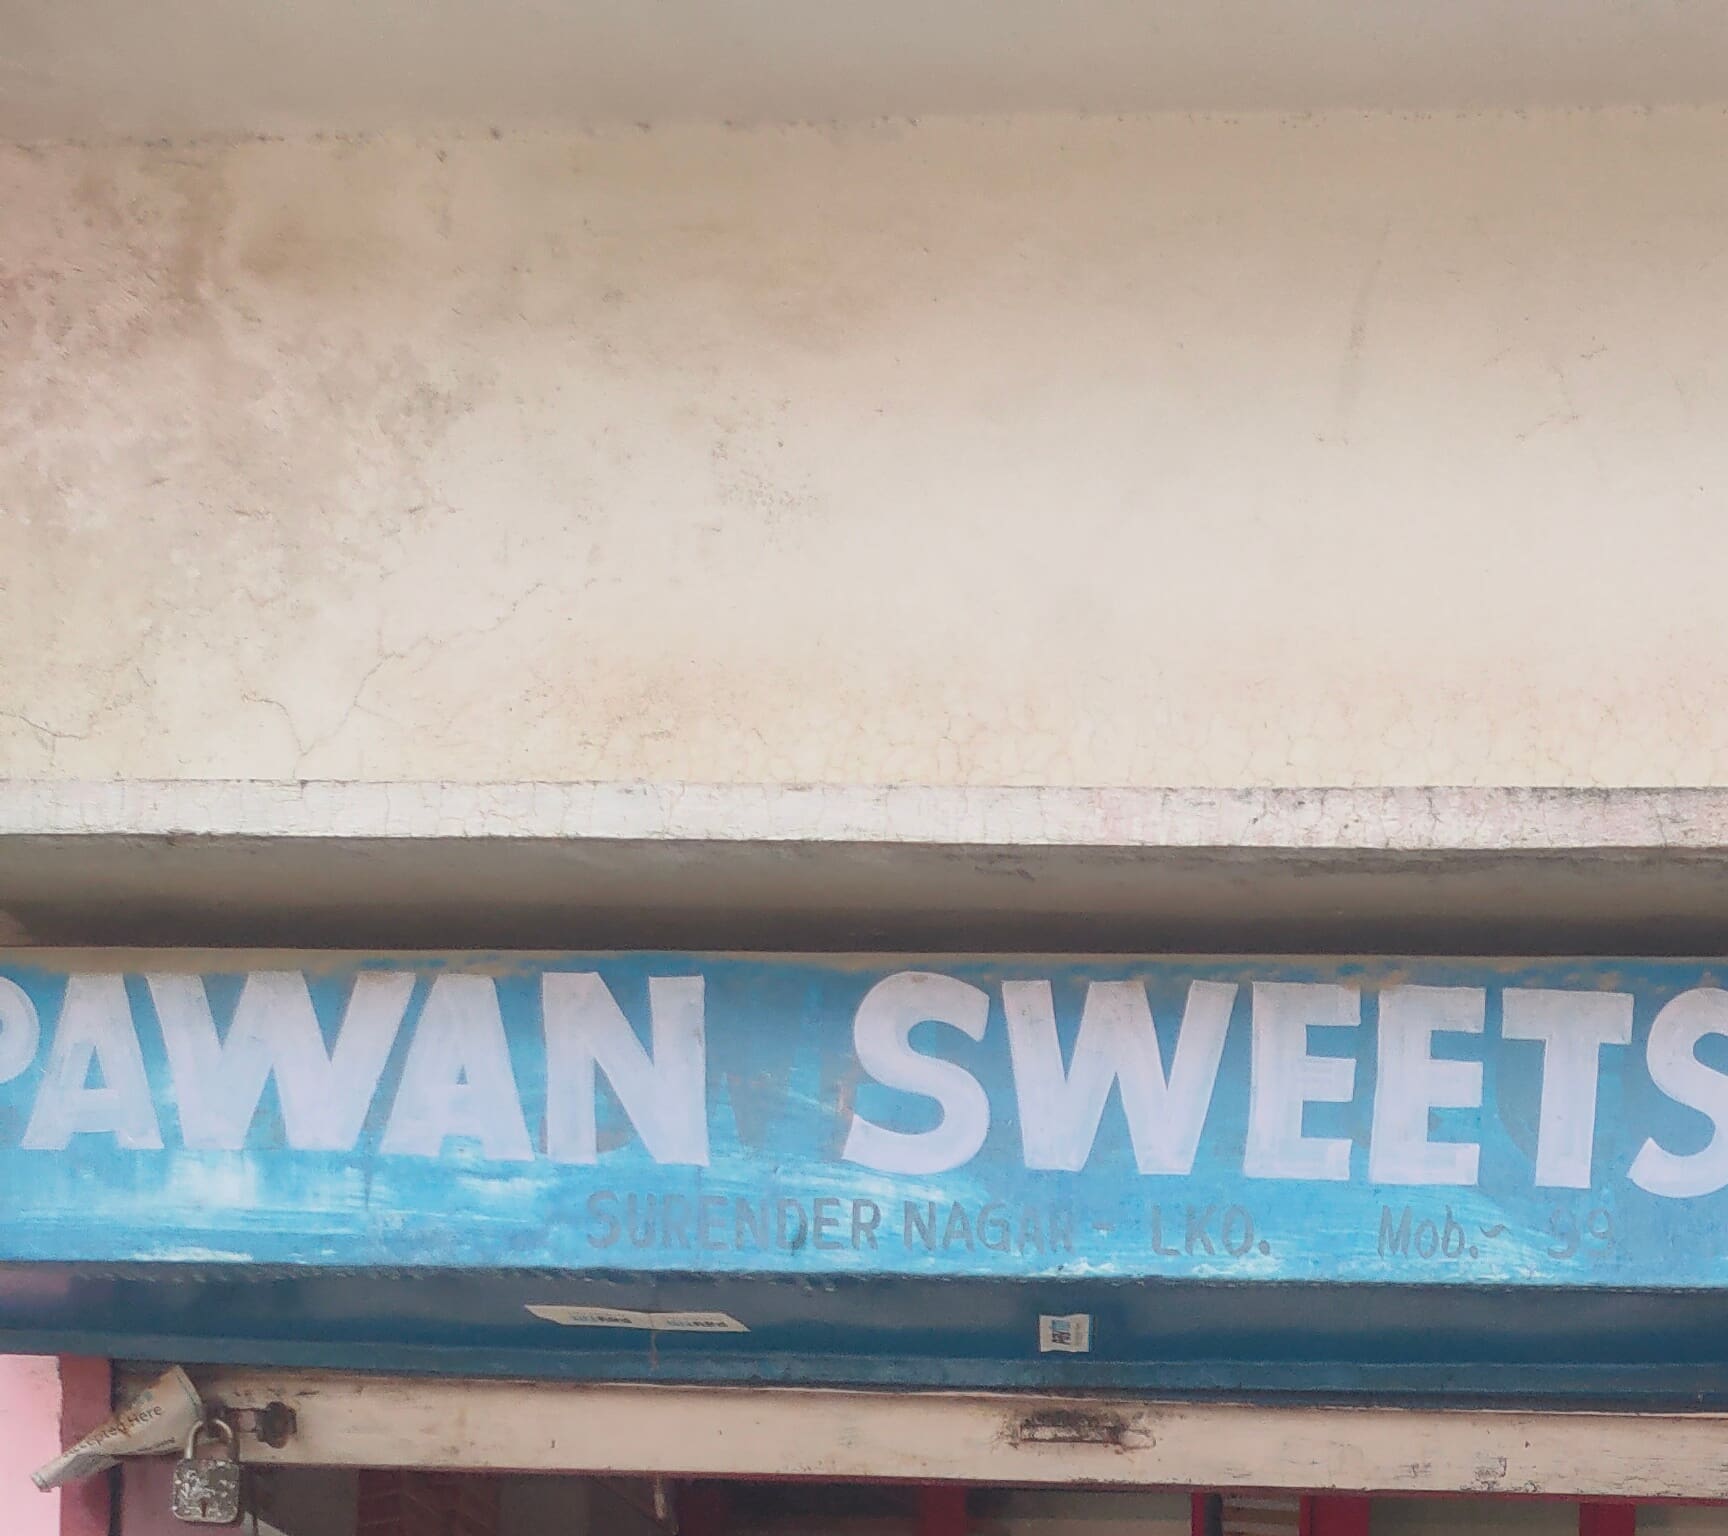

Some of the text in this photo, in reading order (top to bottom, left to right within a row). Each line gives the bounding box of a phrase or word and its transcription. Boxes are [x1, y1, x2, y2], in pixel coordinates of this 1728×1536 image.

[586, 1191, 882, 1252] SURENDER
[903, 1198, 1078, 1256] NAGAR
[1152, 1205, 1272, 1257] LKO.
